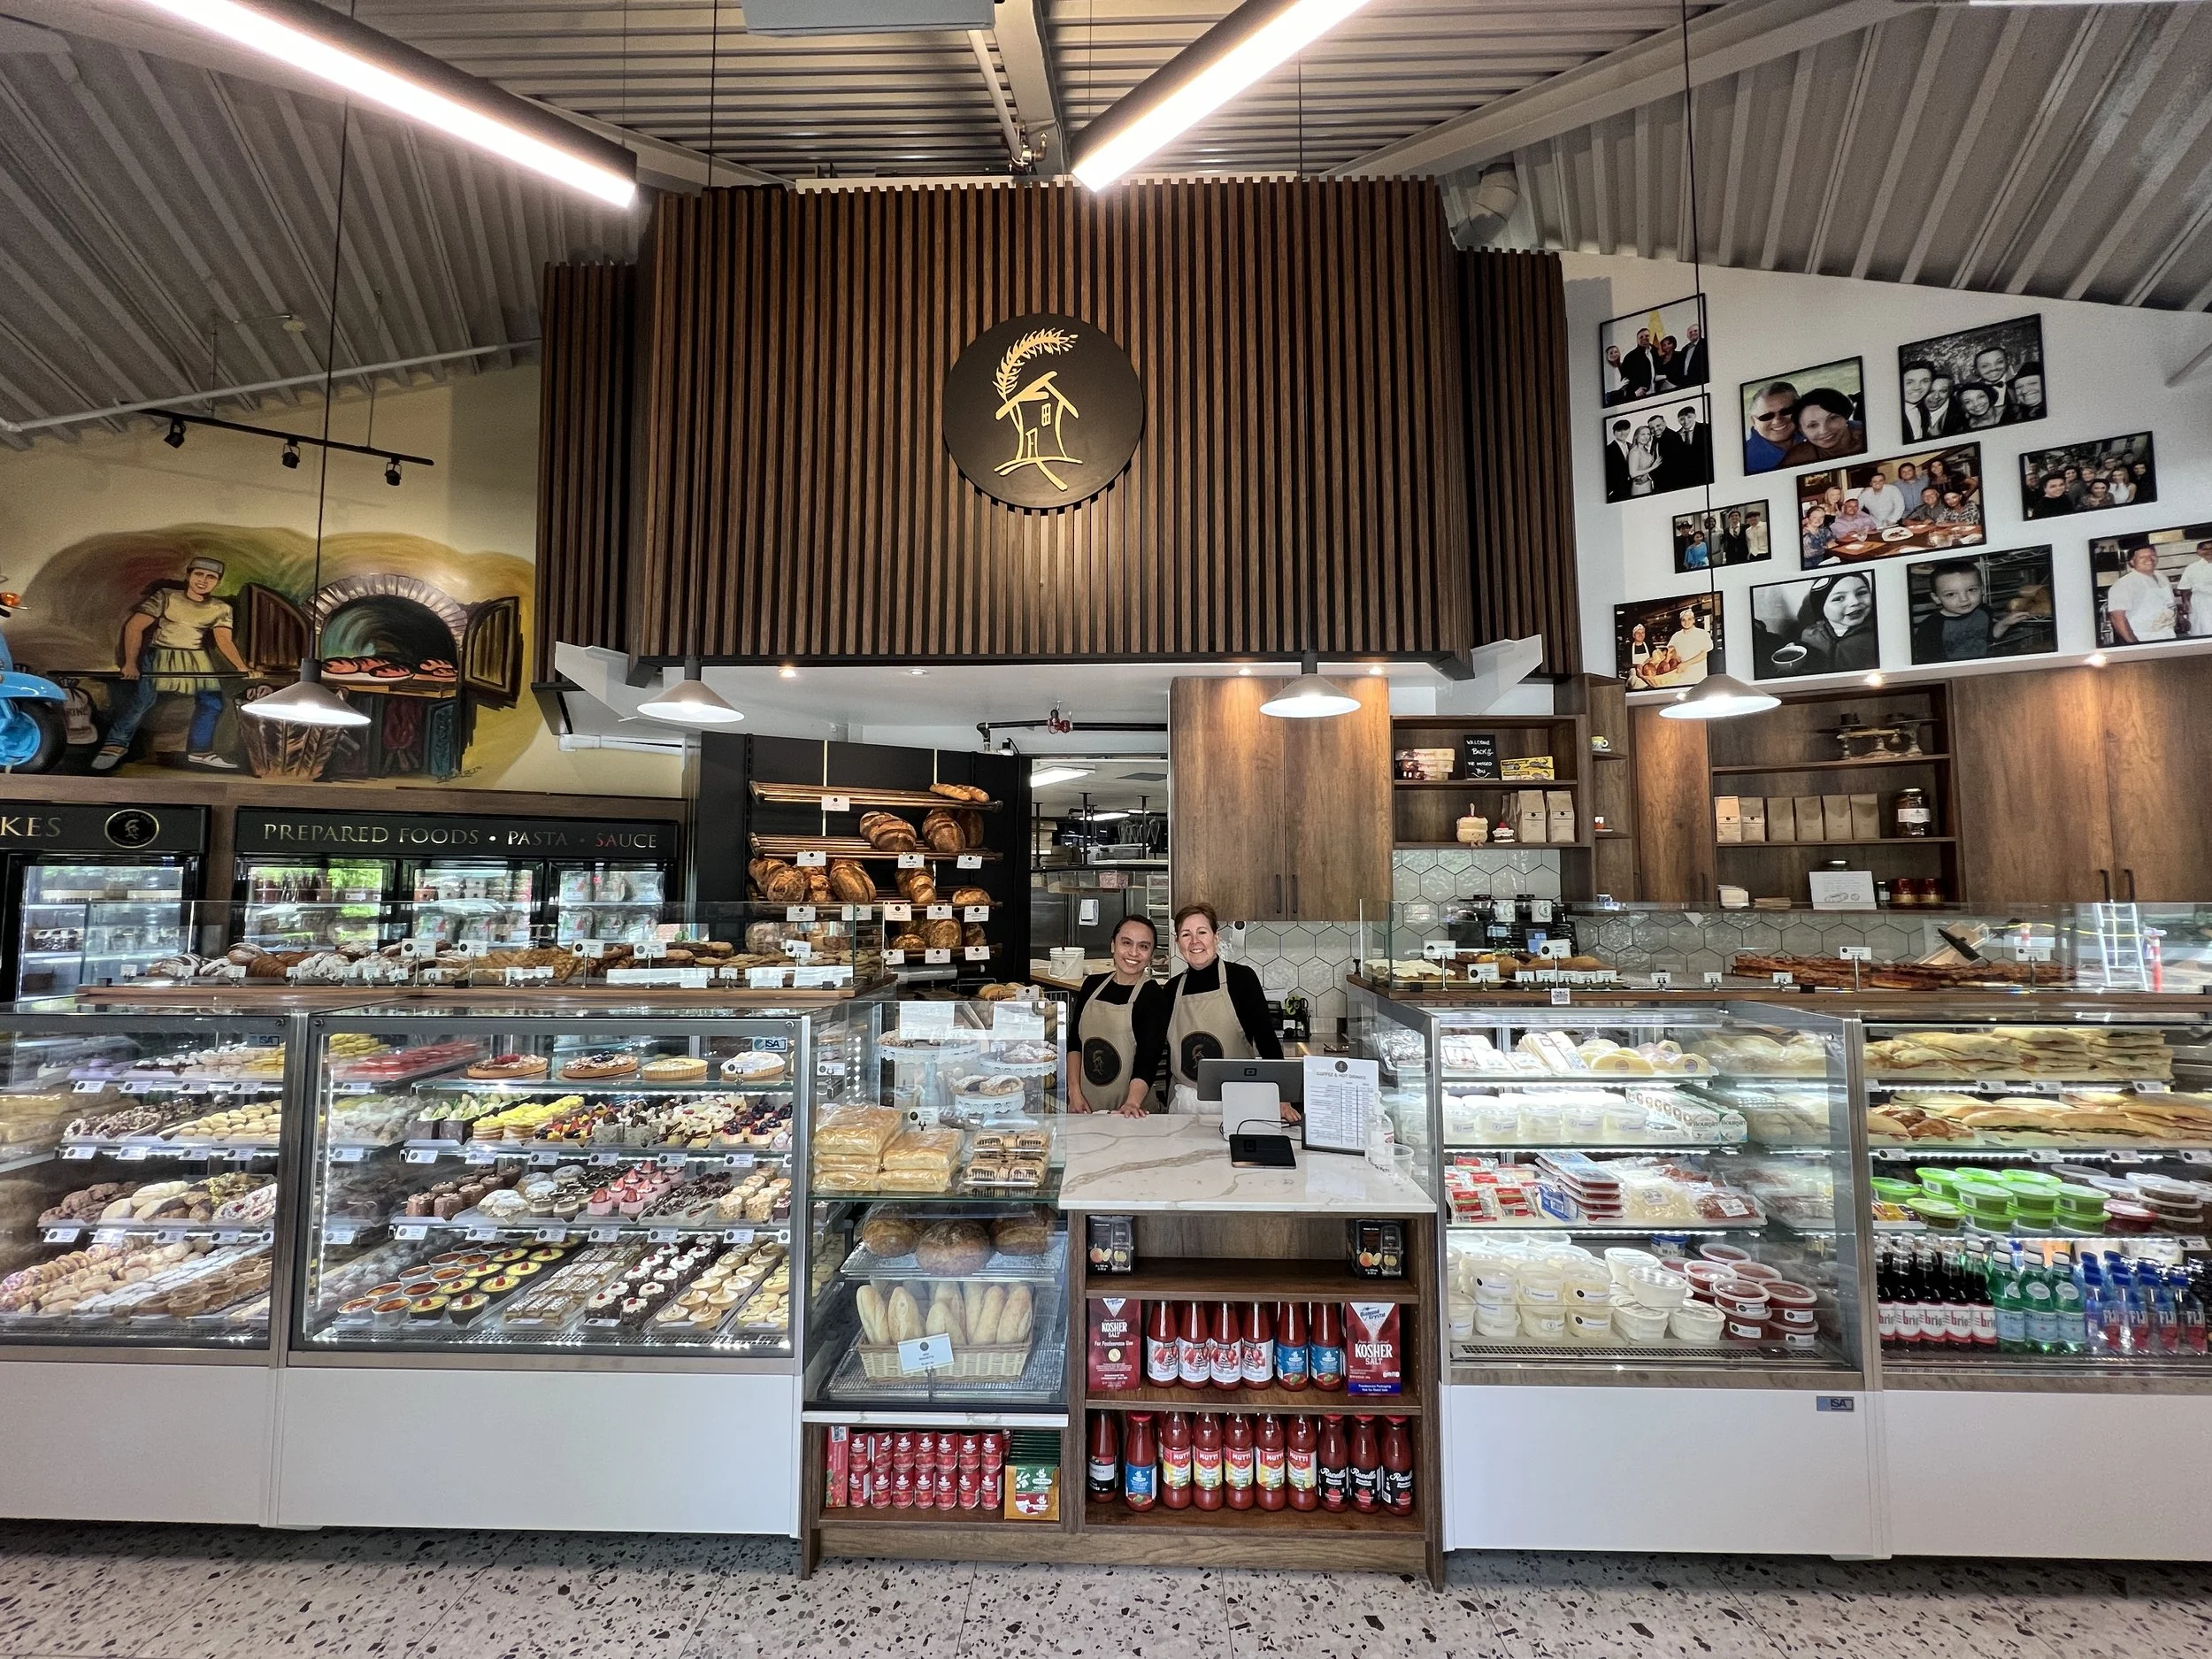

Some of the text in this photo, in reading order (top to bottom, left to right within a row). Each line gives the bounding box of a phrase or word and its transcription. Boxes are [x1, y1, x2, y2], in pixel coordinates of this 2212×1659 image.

[0, 816, 62, 837] KES
[264, 824, 657, 849] PREPARED FOODS PASTA SAUCE
[764, 1039, 780, 1048] ISA
[1102, 1321, 1127, 1333] KOSHER
[1355, 1343, 1394, 1358] KOSHER
[1830, 1398, 1847, 1409] ISA
[1173, 1451, 1189, 1460] MUTT
[1289, 1451, 1309, 1463] MUTTI
